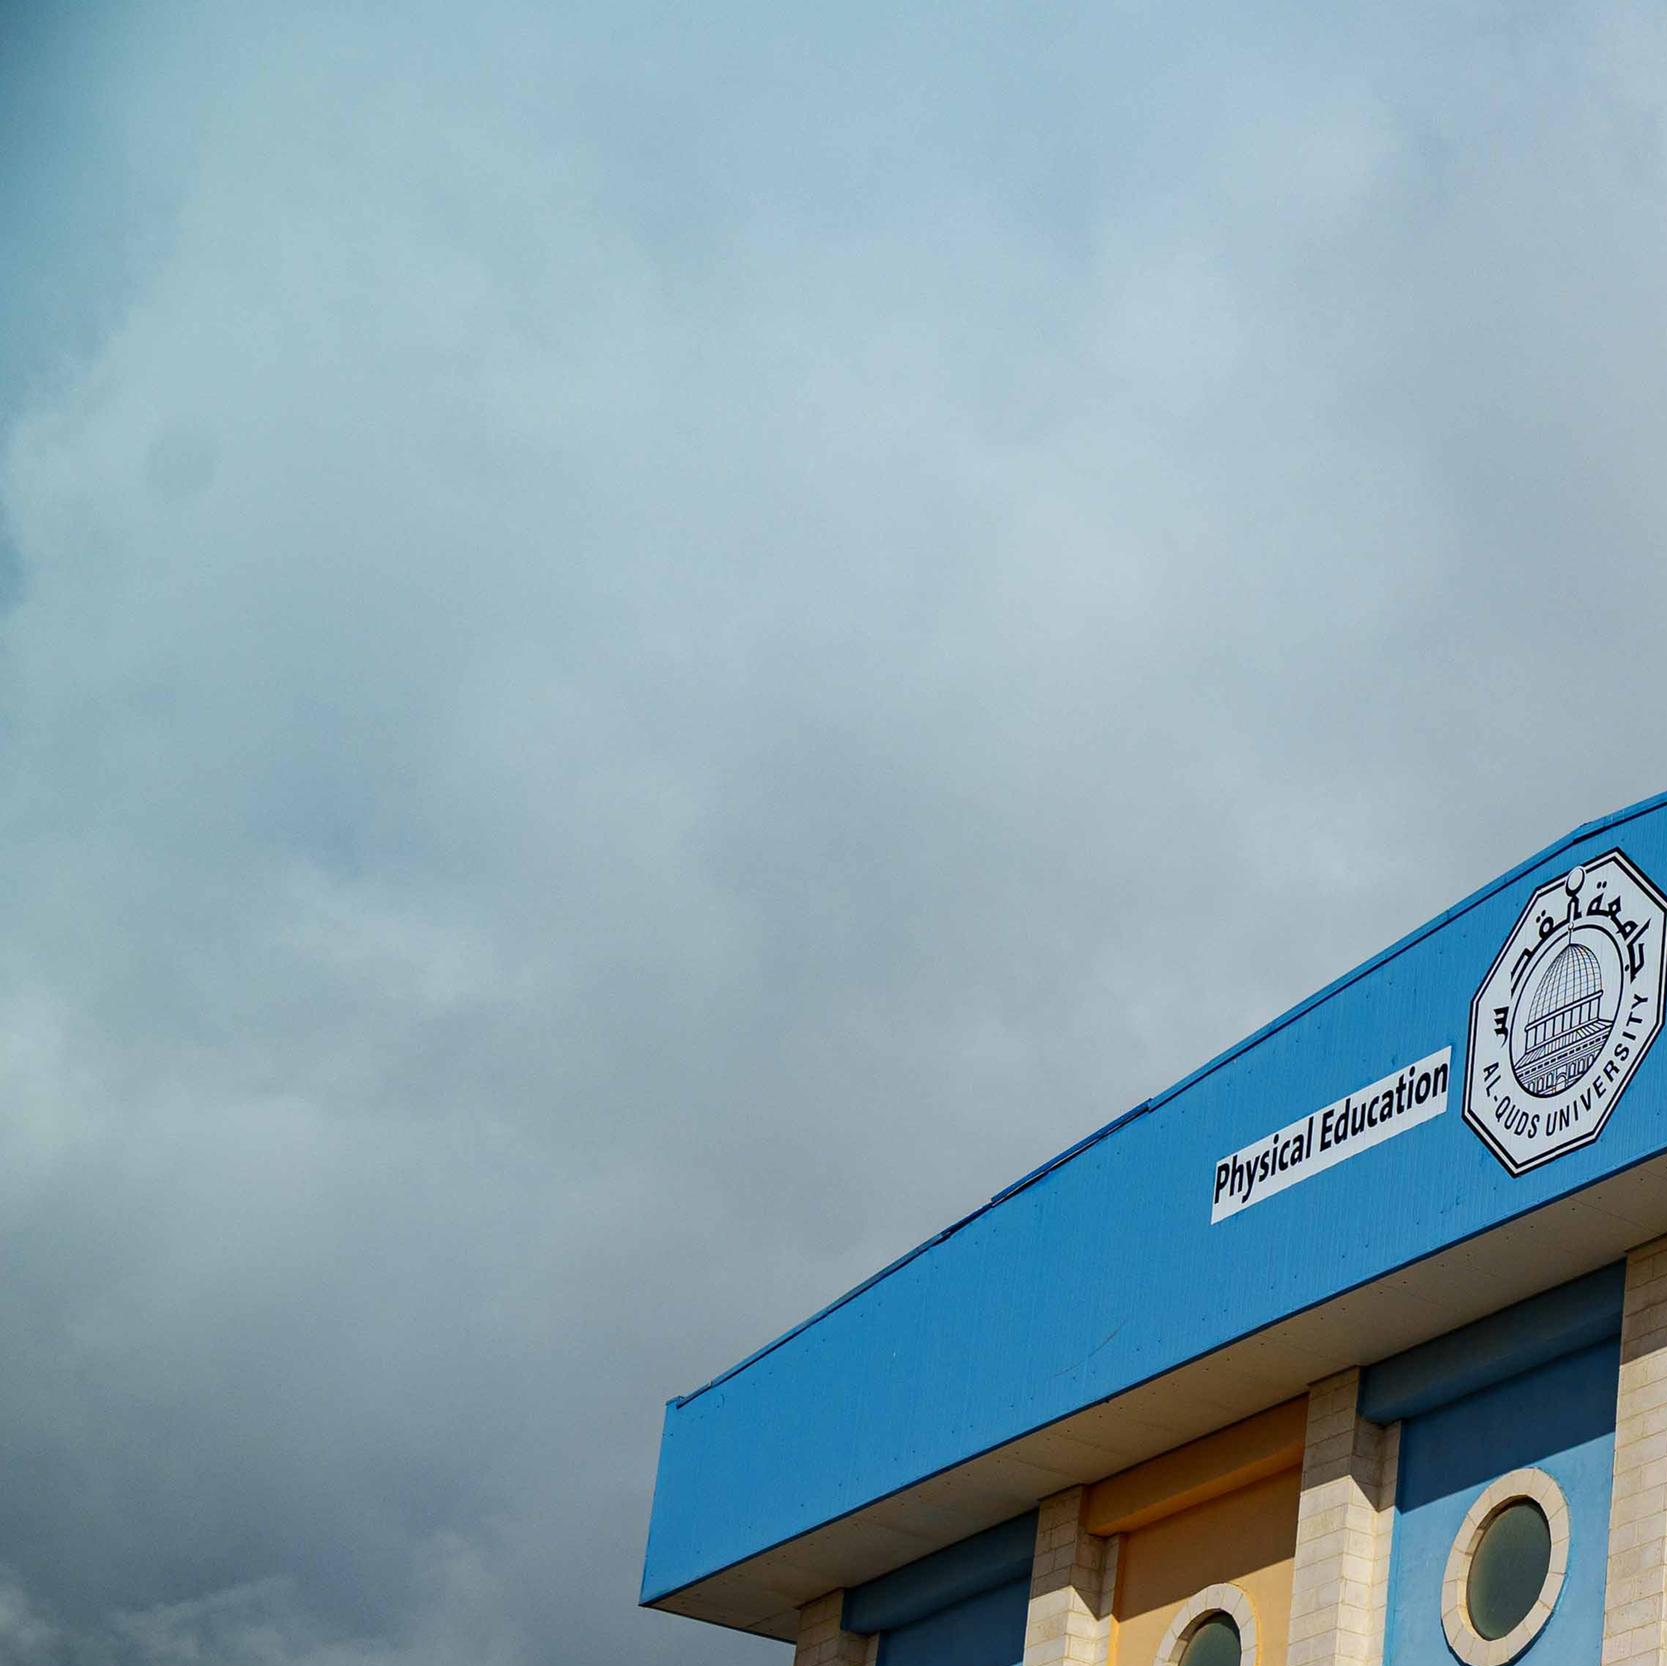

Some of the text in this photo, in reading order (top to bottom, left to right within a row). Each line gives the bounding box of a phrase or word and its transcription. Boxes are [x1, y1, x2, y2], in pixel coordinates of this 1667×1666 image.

[1214, 1061, 1449, 1205] Physical Education
[1545, 993, 1649, 1137] UNIVERSITY
